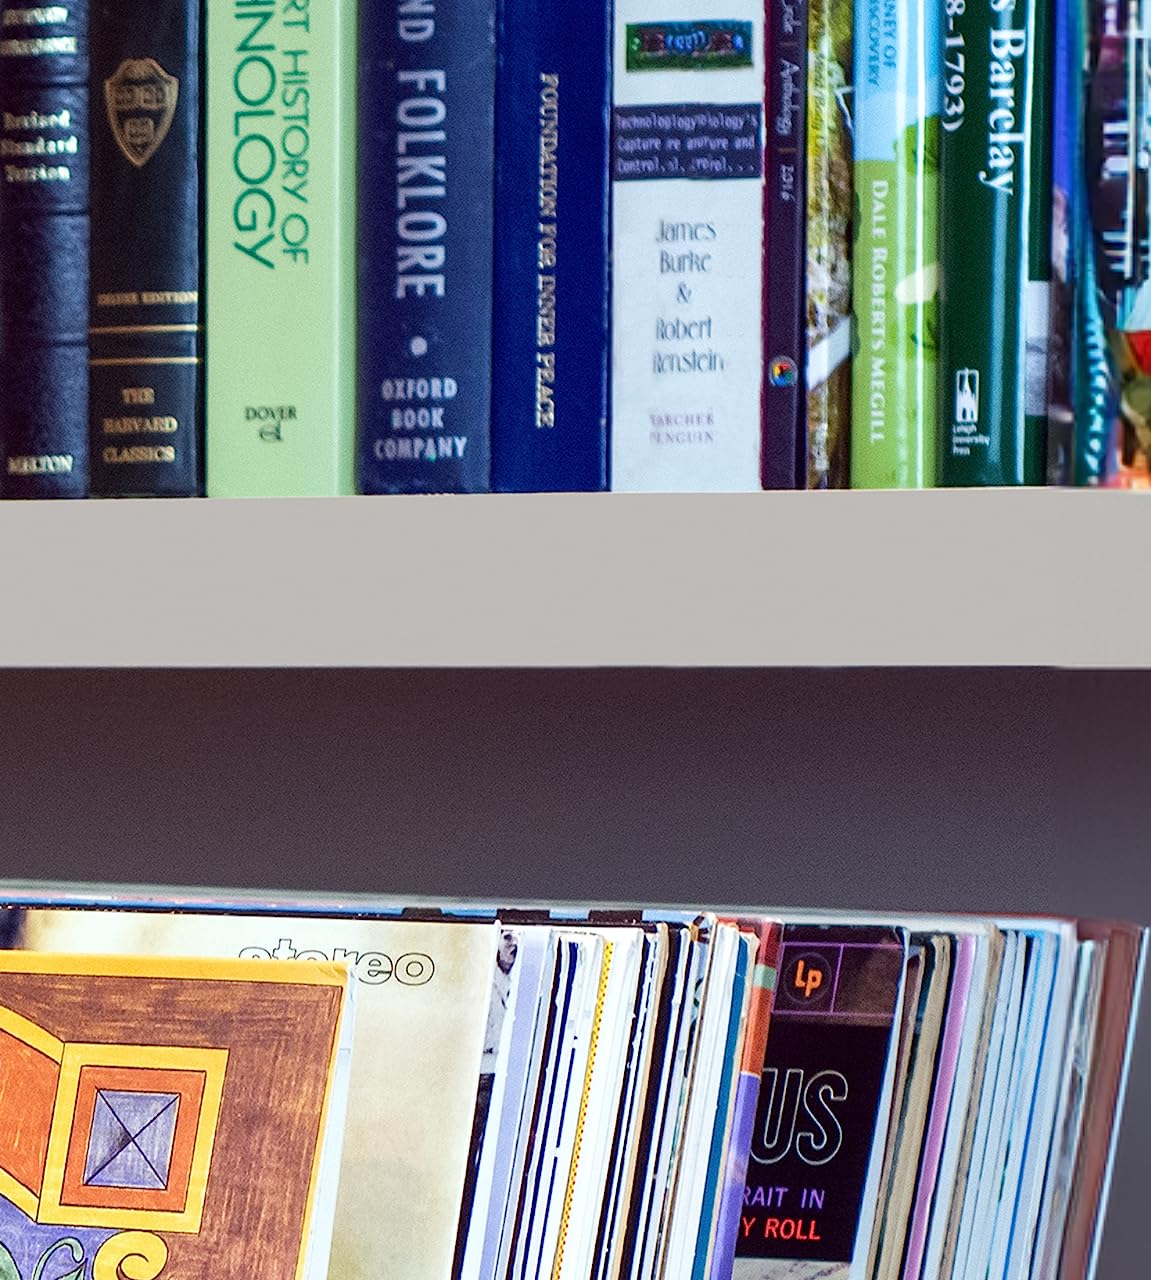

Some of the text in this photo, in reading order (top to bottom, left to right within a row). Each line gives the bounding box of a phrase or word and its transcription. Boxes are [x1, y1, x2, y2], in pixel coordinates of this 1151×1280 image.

[979, 28, 1026, 195] Barclay
[233, 0, 277, 270] NOLOGY
[281, 50, 310, 203] HISTORY
[396, 69, 447, 299] FOLKLORE
[281, 213, 310, 264] OF
[655, 218, 717, 243] James
[535, 72, 560, 429] FOUNDATION FOR INNER PEACE
[660, 249, 712, 274] Burke
[676, 281, 692, 303] &
[869, 179, 890, 445] DALE ROBERTS MEGILL
[655, 316, 713, 342] Robert
[381, 377, 458, 401] OXFORD
[244, 405, 298, 421] DOVER
[391, 407, 446, 430] BOOK
[374, 436, 467, 461] COMPANY
[751, 1068, 848, 1166] US
[800, 1187, 825, 1210] IN
[764, 1217, 821, 1240] ROLL
